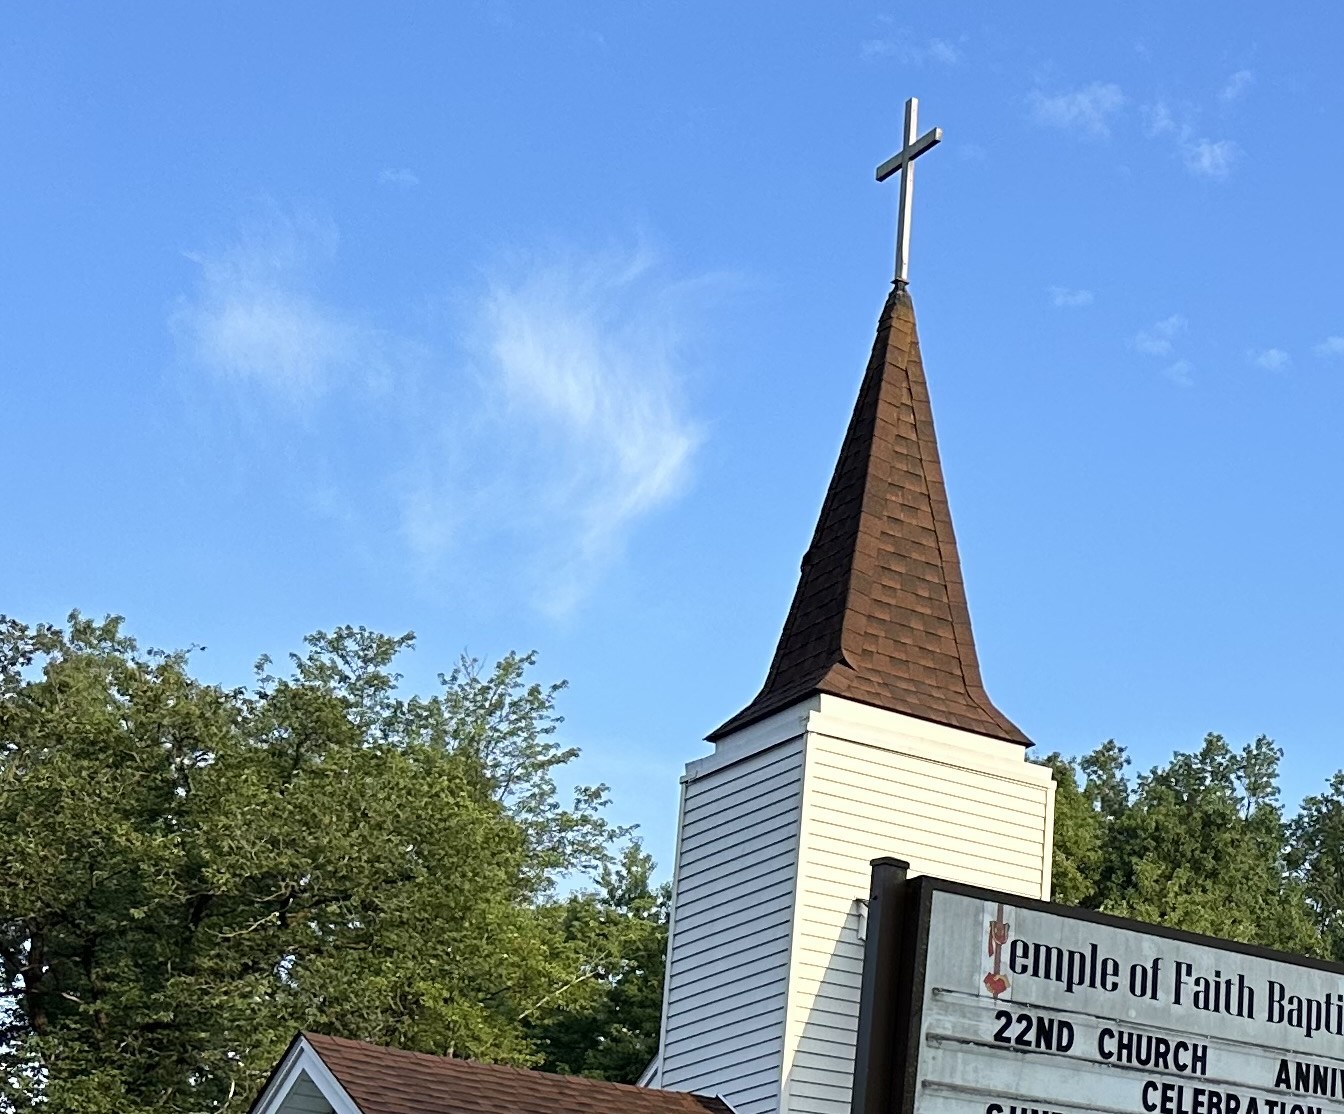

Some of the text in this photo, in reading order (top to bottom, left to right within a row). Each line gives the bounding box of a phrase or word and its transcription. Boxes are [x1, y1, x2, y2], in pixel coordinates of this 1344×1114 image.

[1129, 957, 1163, 1001] of
[1172, 960, 1255, 1020] Faith
[993, 1010, 1075, 1052] 22ND
[1098, 1028, 1208, 1075] CHURCH
